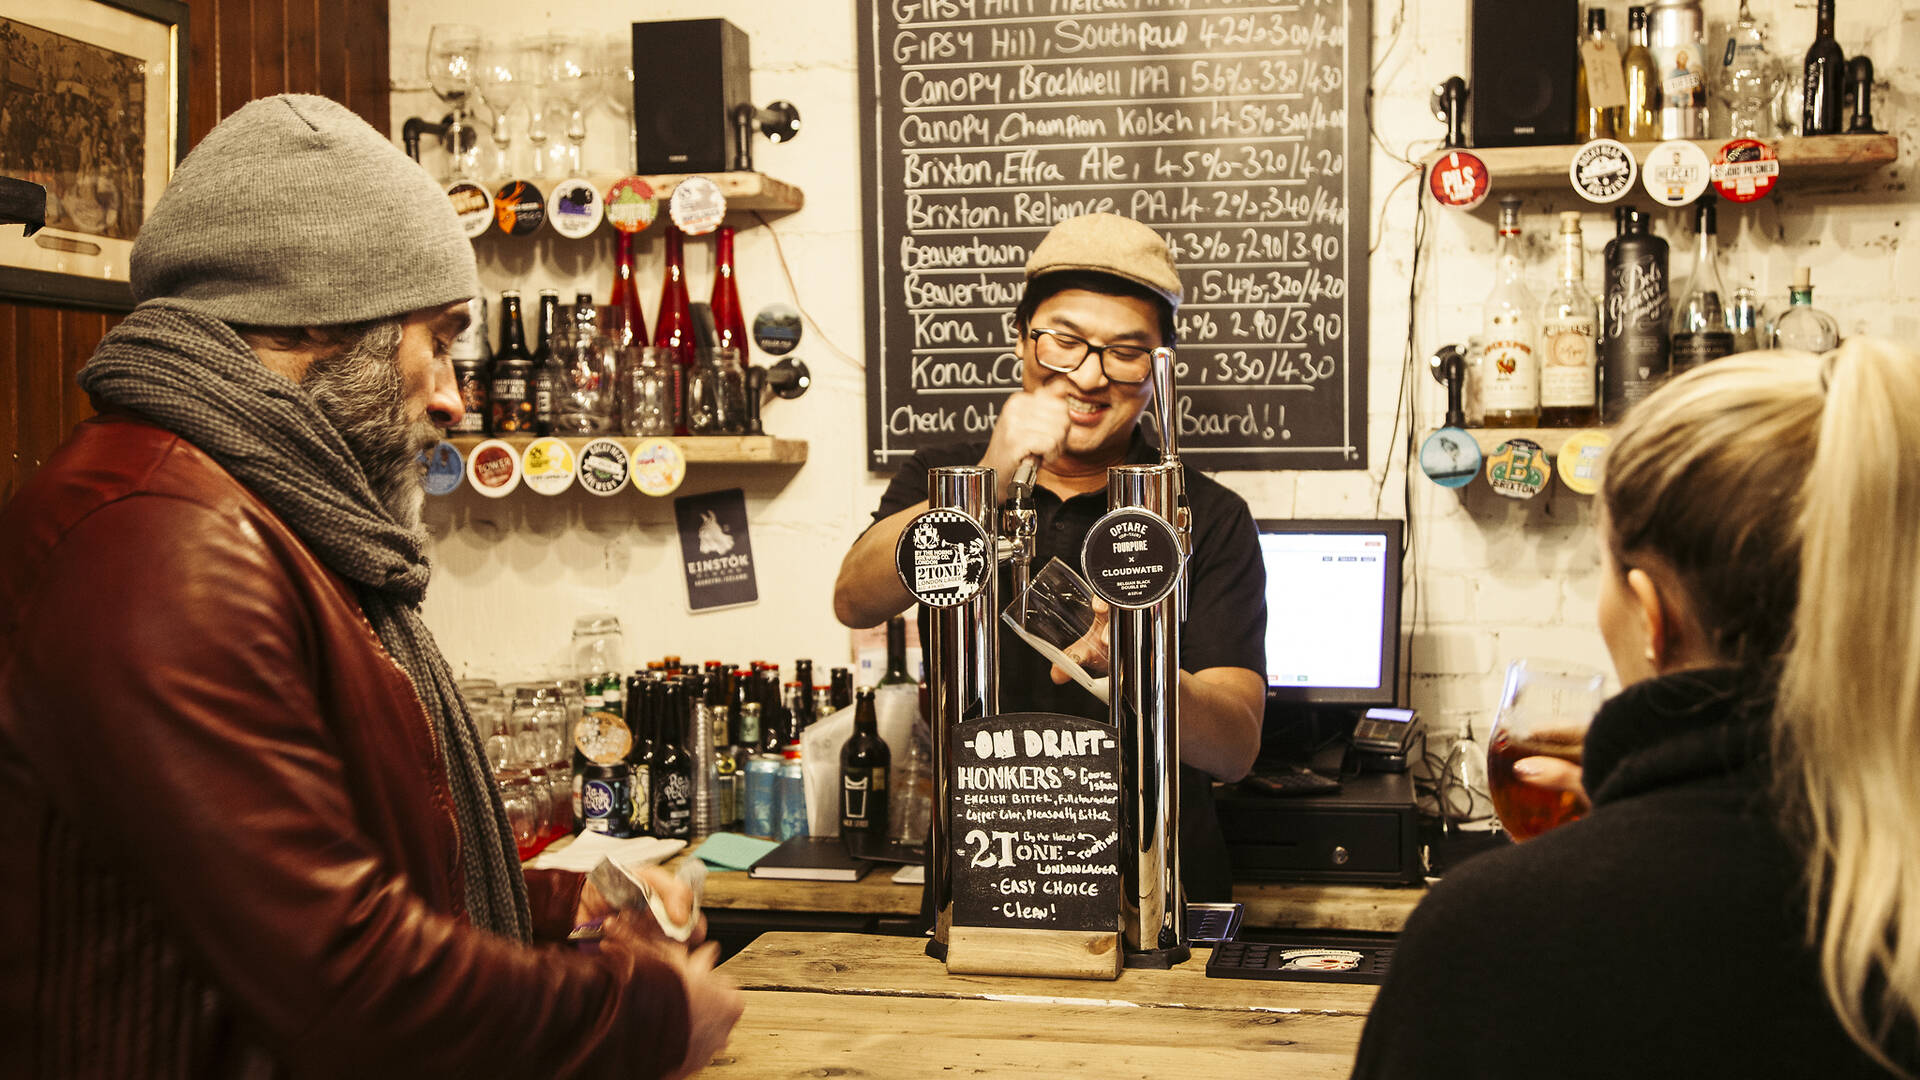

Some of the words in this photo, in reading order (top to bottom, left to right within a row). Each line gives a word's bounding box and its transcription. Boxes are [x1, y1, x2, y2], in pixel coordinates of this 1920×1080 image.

[1055, 19, 1188, 52] Southpaw
[1019, 64, 1121, 99] Brockwell
[1000, 112, 1106, 142] Champion
[1003, 148, 1065, 184] Effra
[889, 404, 957, 435] Check
[963, 402, 999, 433] Out
[1493, 479, 1538, 494] BRIXTON
[1110, 522, 1148, 537] OPTARE
[1113, 540, 1148, 553] FOURPURE
[1102, 565, 1163, 577] CLOUDWATER
[958, 766, 1062, 790] HONKERS
[1042, 880, 1099, 897] CHOICE
